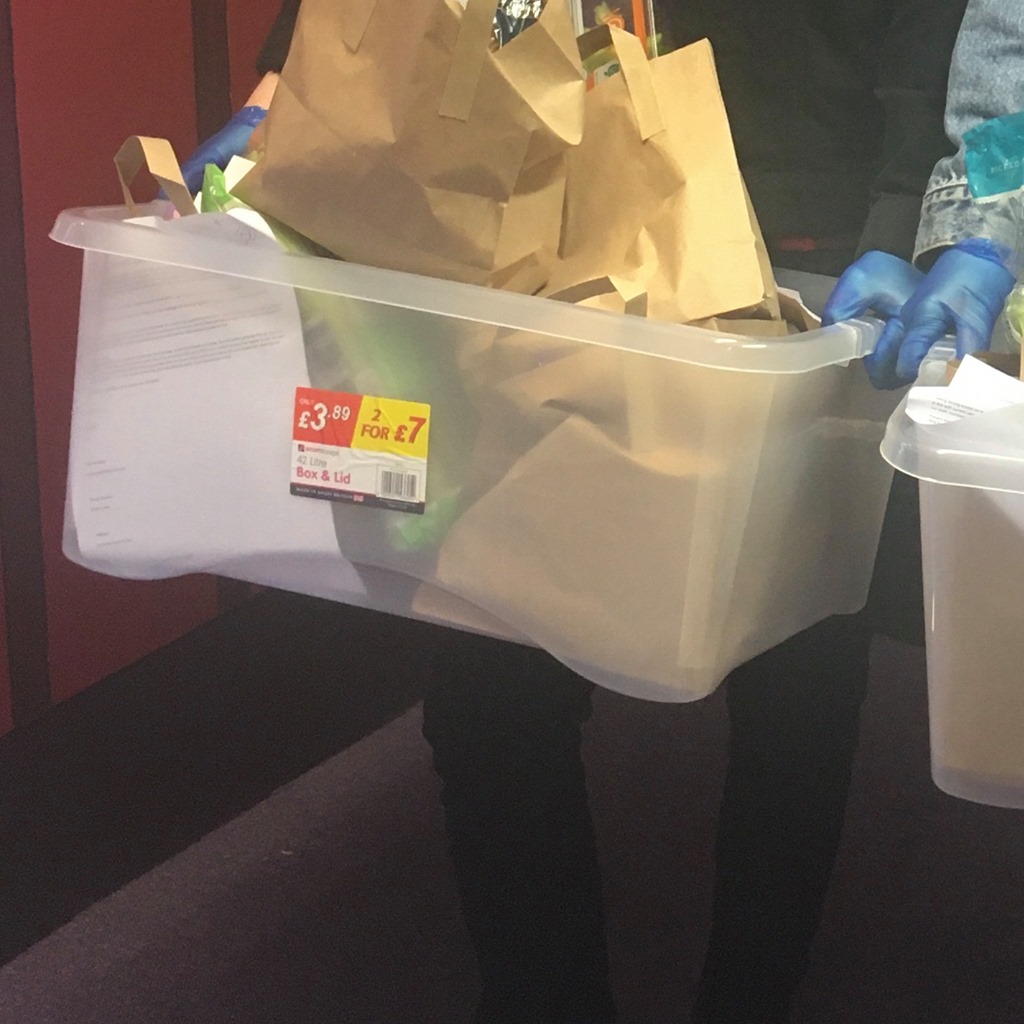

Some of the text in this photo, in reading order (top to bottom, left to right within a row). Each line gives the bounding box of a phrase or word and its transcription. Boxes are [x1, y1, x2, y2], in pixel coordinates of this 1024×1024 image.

[298, 402, 351, 431] £3.89
[371, 408, 382, 422] 2
[360, 416, 427, 444] FOR £7
[296, 455, 328, 468] 42 Litre
[296, 466, 351, 485] Box & Lid
